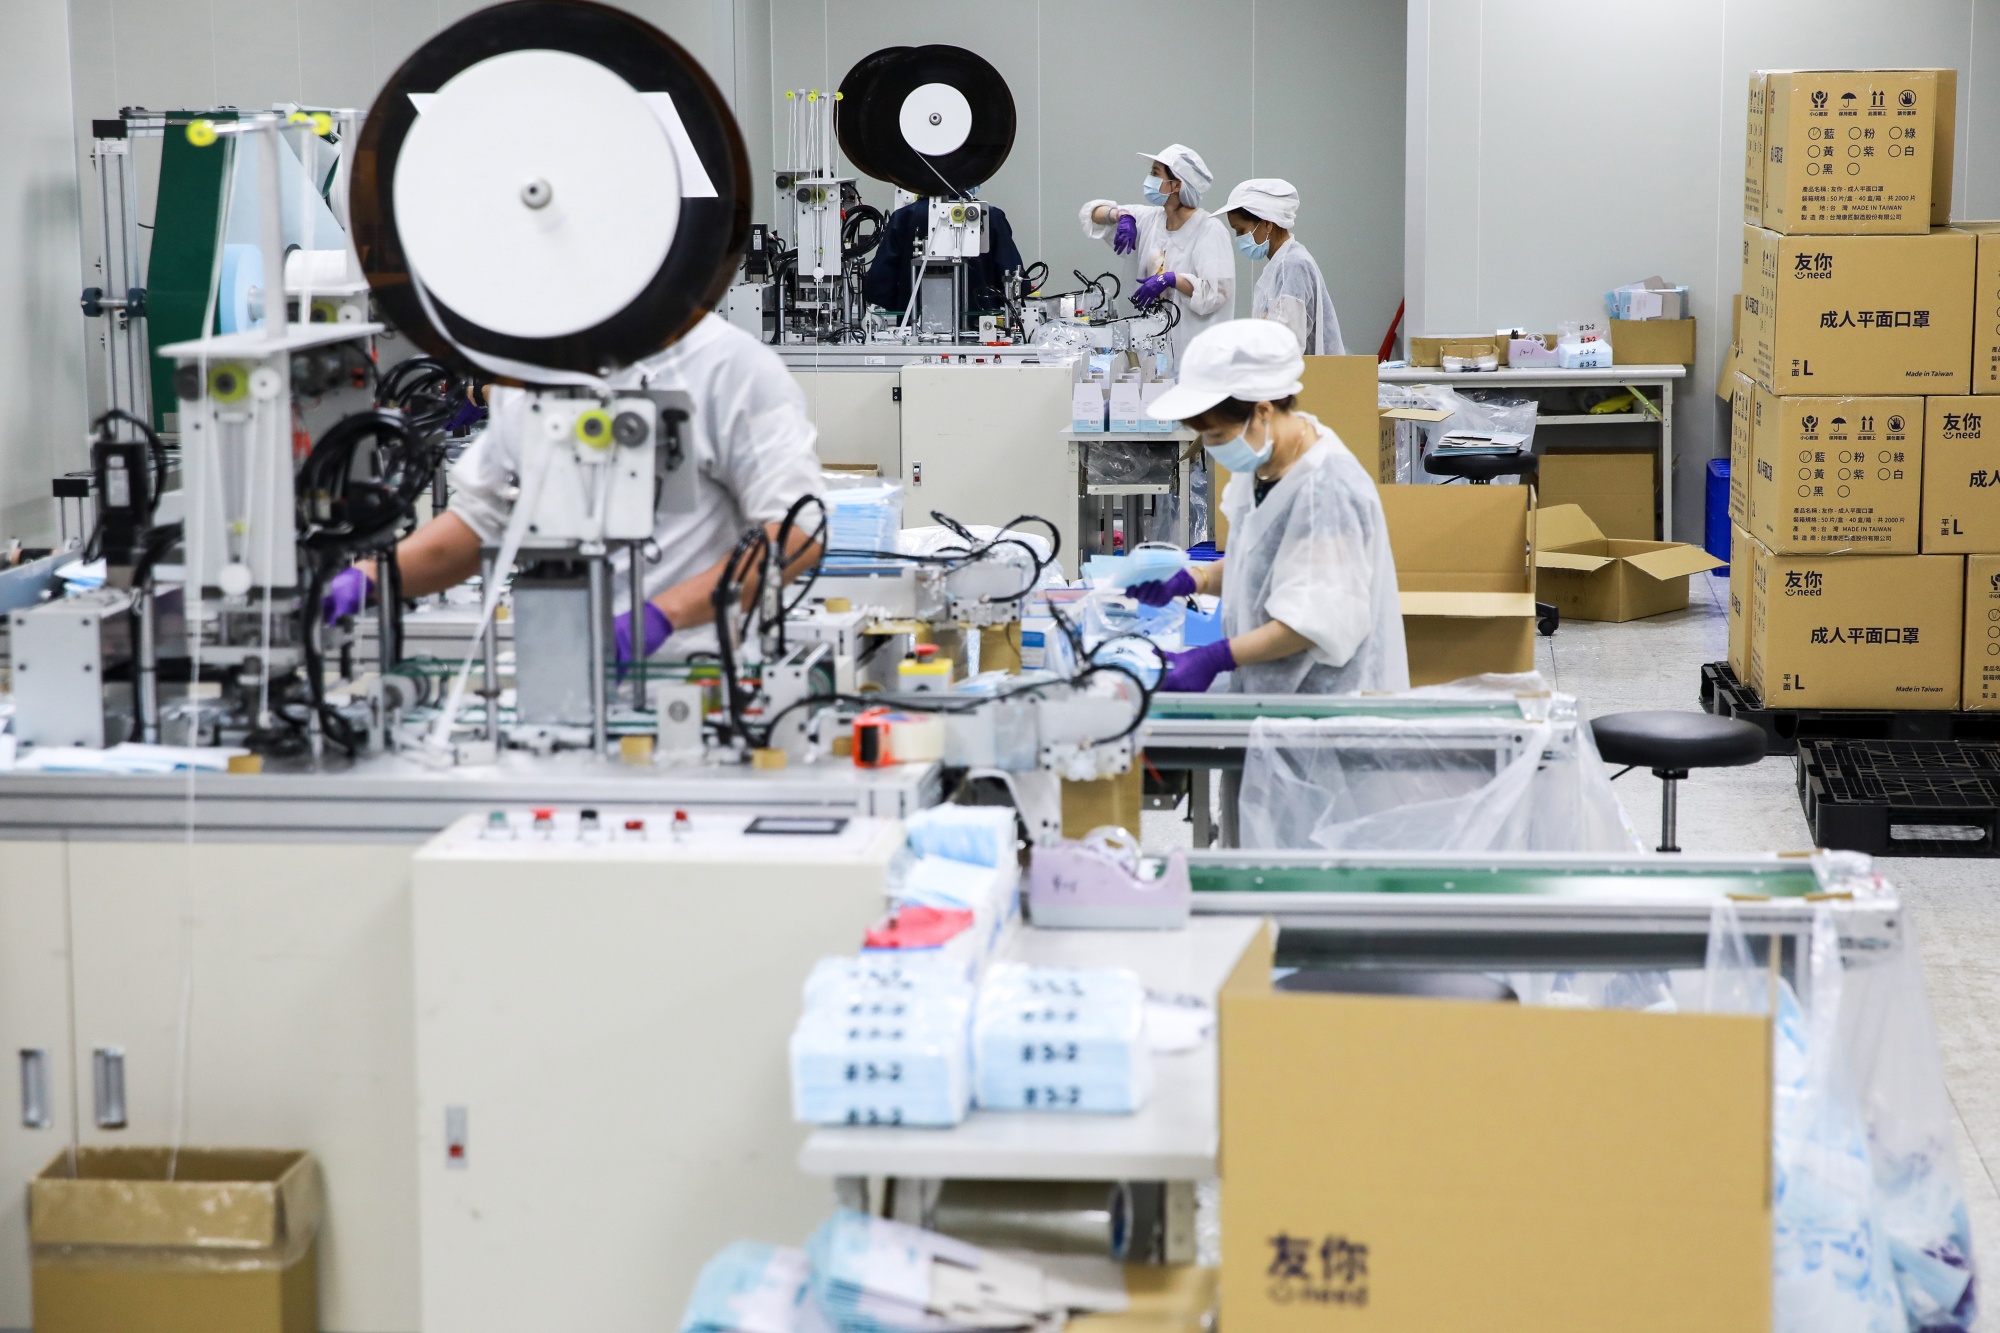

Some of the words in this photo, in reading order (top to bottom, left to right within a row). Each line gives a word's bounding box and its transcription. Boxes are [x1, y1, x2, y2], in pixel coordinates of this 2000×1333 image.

[1824, 129, 1835, 139] 藍
[1864, 128, 1875, 139] 粉
[1905, 128, 1915, 138] 綠
[1824, 146, 1833, 157] 黃
[1864, 146, 1874, 157] 紫
[1905, 146, 1914, 156] 白
[1823, 164, 1833, 174] 黑
[1794, 252, 1833, 271] 友你
[1807, 270, 1832, 279] need
[1820, 311, 1930, 328] 成人平面口罩
[1804, 360, 1813, 375] L
[1942, 412, 1982, 431] 友你
[1955, 430, 1981, 439] need
[1815, 452, 1825, 462] 藍
[1854, 452, 1864, 462] 粉
[1894, 452, 1904, 462] 綠
[1814, 469, 1824, 479] 黃
[1854, 469, 1864, 480] 紫
[1894, 469, 1903, 479] 白
[1813, 486, 1823, 496] 黑
[1953, 519, 1963, 534] L
[1785, 570, 1823, 588] 友你
[1797, 588, 1822, 597] need
[1811, 627, 1919, 644] 成人平面口罩
[1795, 674, 1805, 690] L
[1265, 1231, 1369, 1284] 友你
